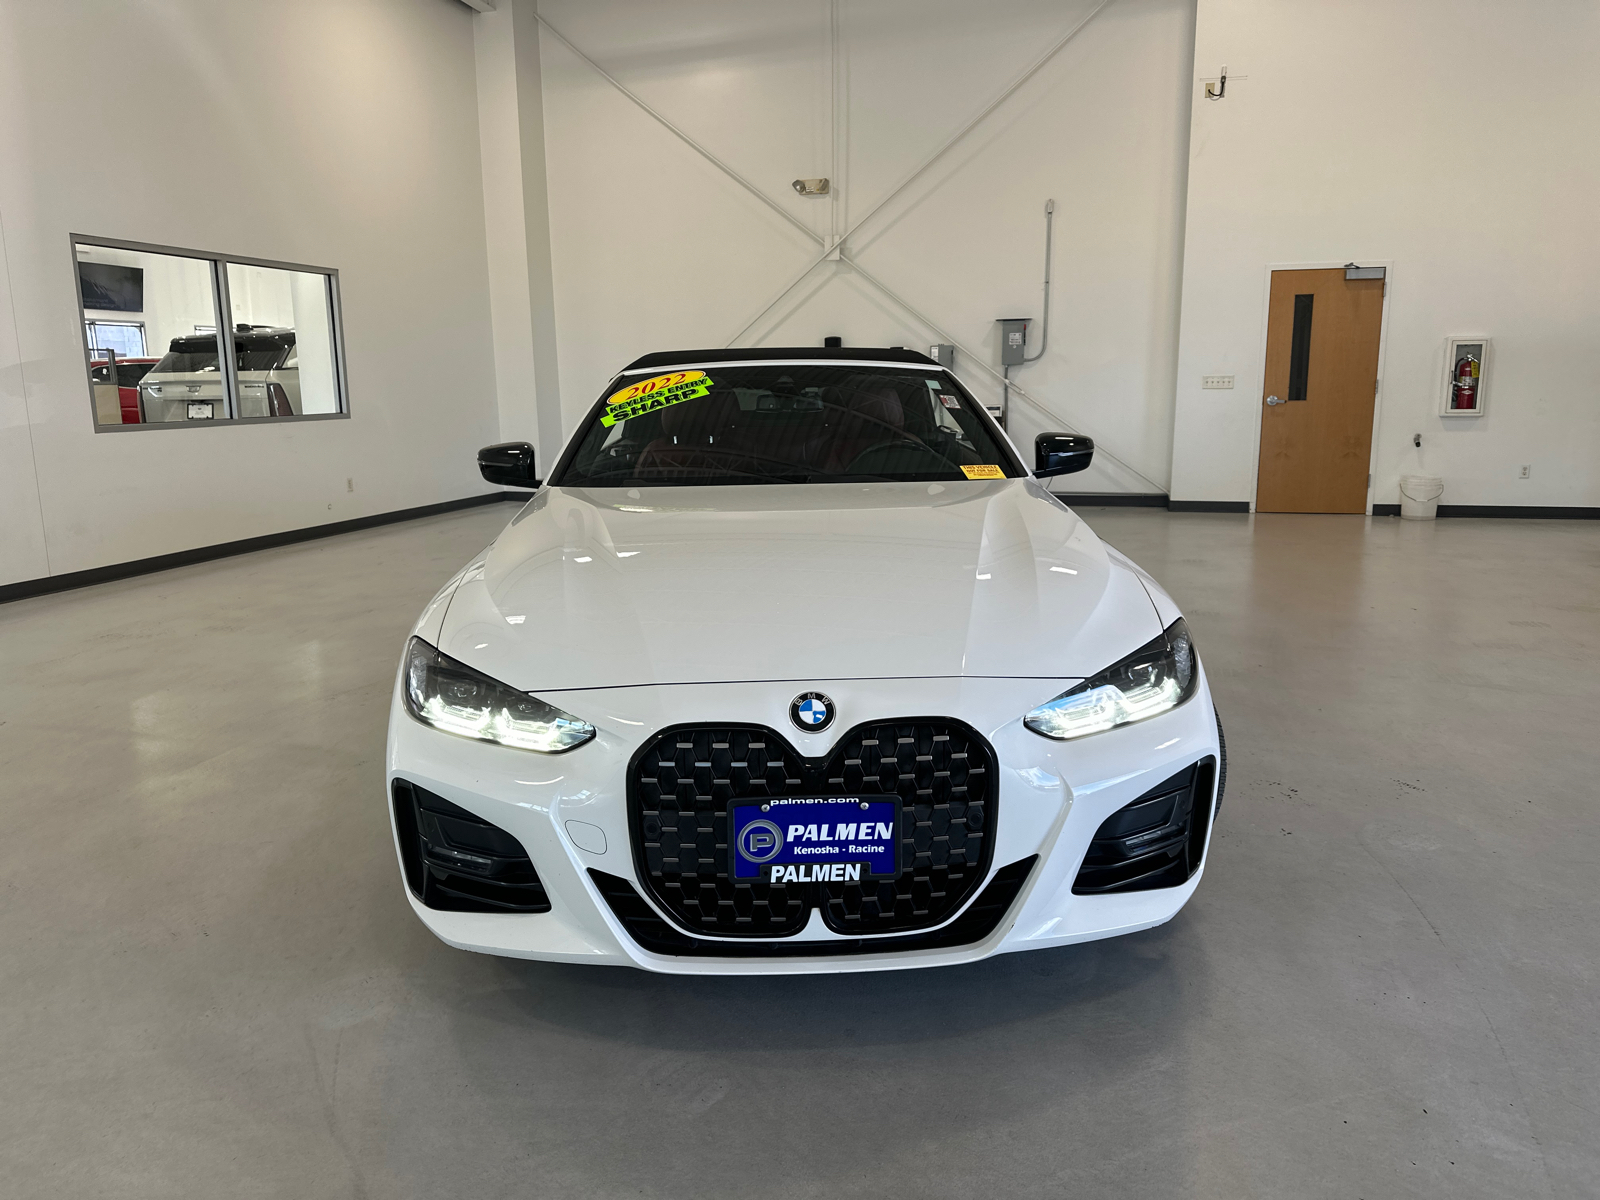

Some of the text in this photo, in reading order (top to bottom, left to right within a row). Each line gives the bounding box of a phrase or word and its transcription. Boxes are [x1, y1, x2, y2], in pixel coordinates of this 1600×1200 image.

[610, 378, 709, 414] KEYLESS ENTRY
[626, 373, 687, 400] 2022
[612, 388, 700, 422] SHARP
[794, 692, 831, 706] BMW
[770, 797, 860, 806] palmen.com
[786, 822, 894, 842] PALMEN
[793, 846, 839, 855] Kenosha
[848, 845, 885, 853] Racine
[770, 863, 861, 883] PALMEN
